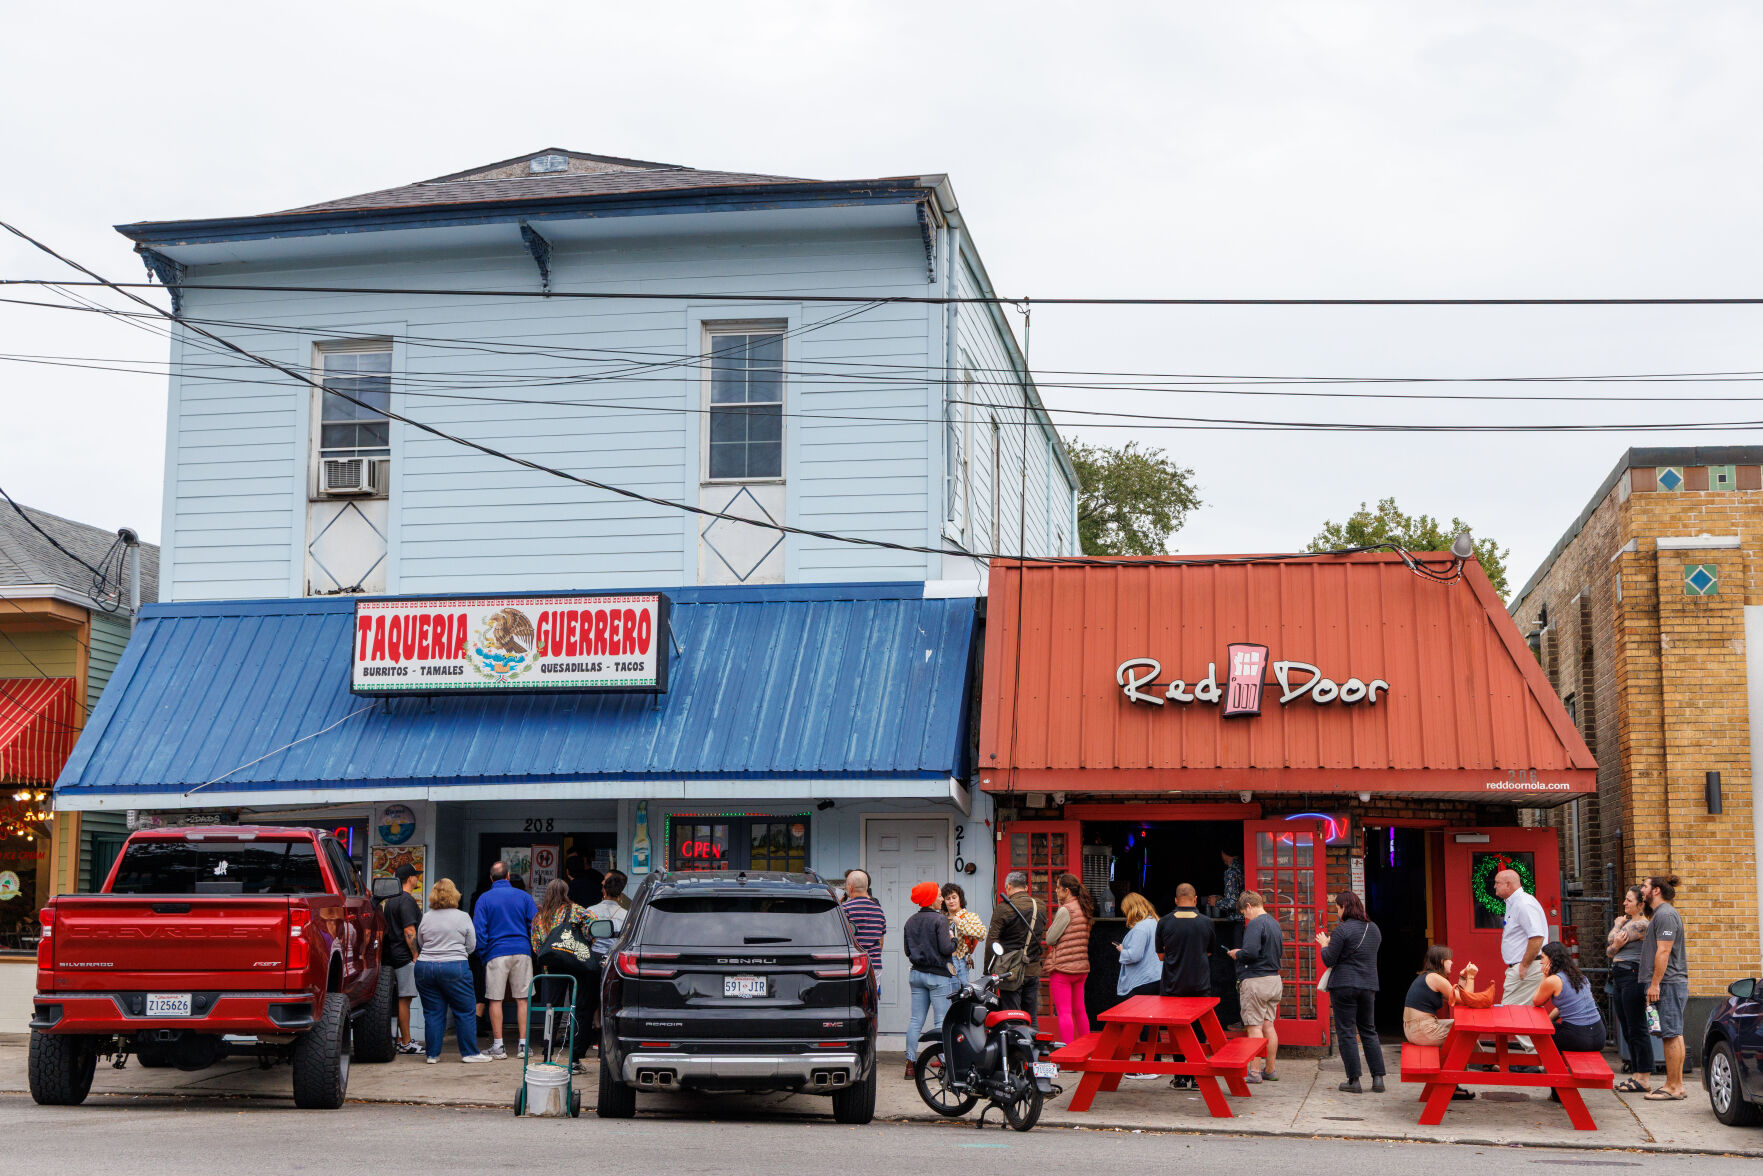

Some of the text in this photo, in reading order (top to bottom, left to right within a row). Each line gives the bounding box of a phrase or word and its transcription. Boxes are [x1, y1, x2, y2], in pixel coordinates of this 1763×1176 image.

[358, 608, 651, 664] TAQUERIA GUERRERO
[363, 666, 409, 677] BURRITOS
[420, 665, 464, 676] TAMALES
[540, 663, 603, 674] QUESADILLAS
[614, 662, 645, 673] TACOS
[1116, 657, 1390, 707] Red Door
[1486, 780, 1570, 790] reddoornola.com
[523, 818, 554, 833] 208
[682, 840, 721, 859] OPEN
[955, 825, 965, 873] 210
[71, 927, 272, 938] CHEVROLET
[725, 981, 765, 992] 591 JIR
[149, 1000, 188, 1011] Z125626
